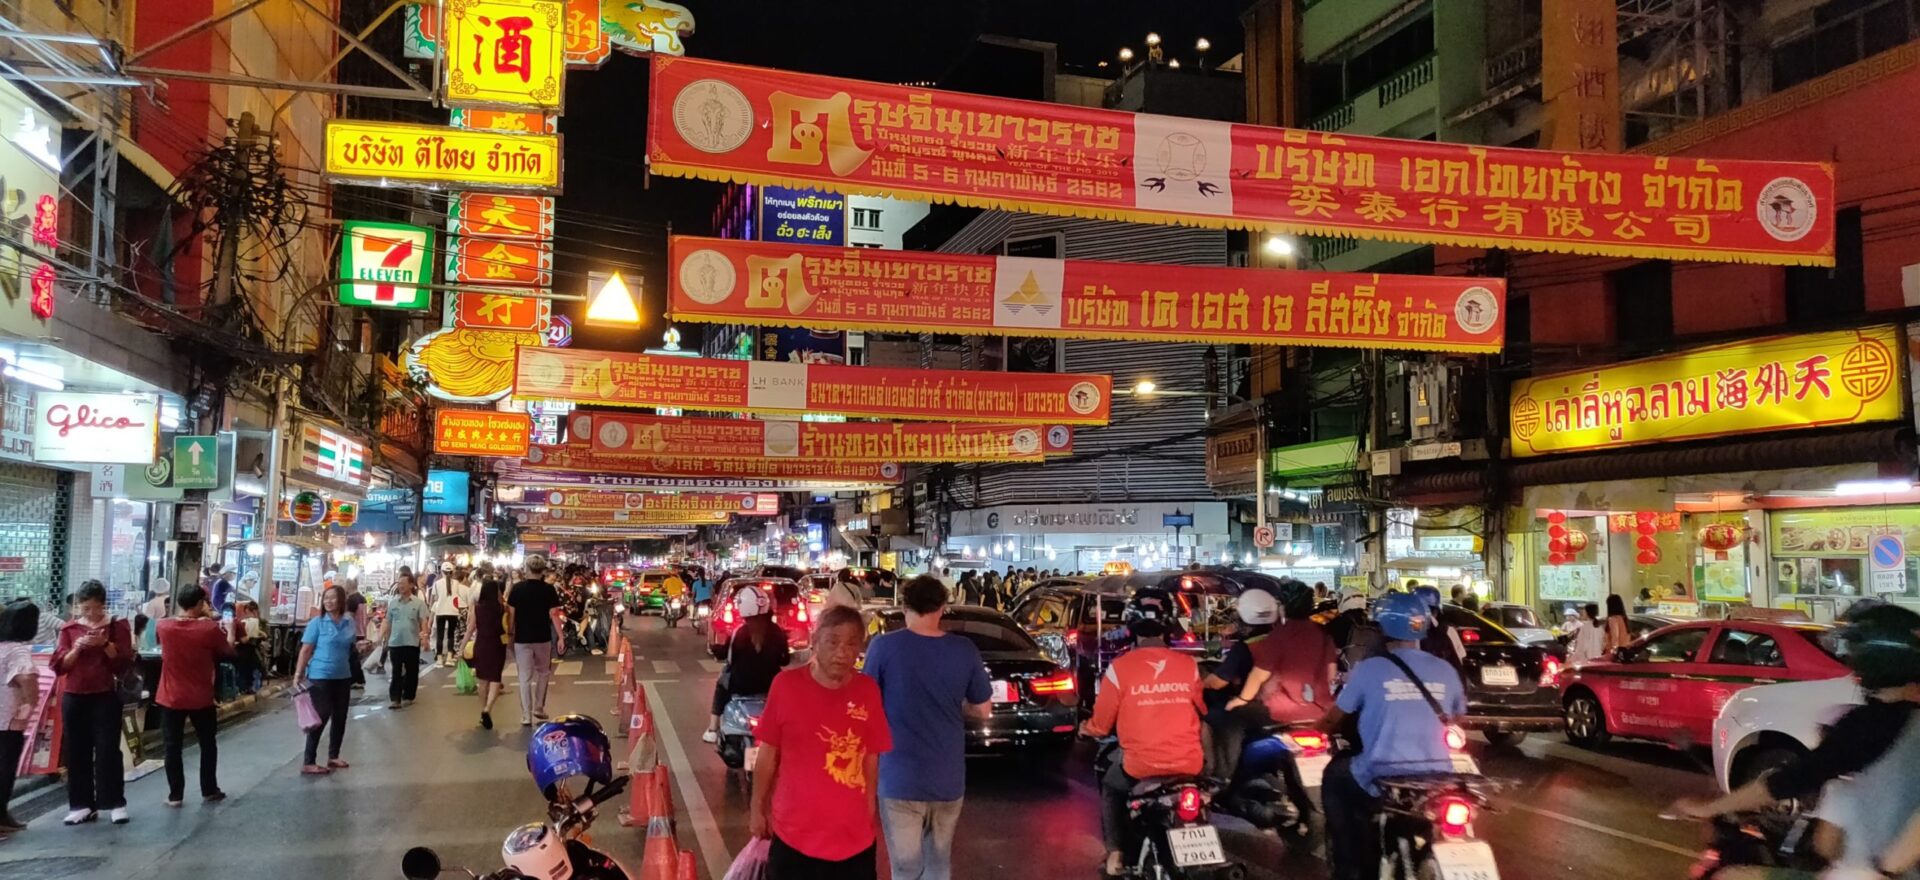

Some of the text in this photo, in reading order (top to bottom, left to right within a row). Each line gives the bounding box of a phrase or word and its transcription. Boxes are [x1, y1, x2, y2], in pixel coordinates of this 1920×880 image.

[473, 16, 533, 83] 酒
[343, 135, 541, 175] บริษัท ดีไทย จำกัด
[767, 91, 1120, 176] ตรุษจีนเยาวราช
[1007, 143, 1118, 168] 新年快乐
[872, 155, 906, 179] วันที่
[965, 168, 1057, 193] กุมภาพันธ์
[1067, 180, 1122, 199] 2562
[1256, 129, 1375, 187] บริษัท
[1401, 146, 1622, 205] เอกไทยห้าง
[1643, 157, 1743, 212] จำกัด
[812, 225, 832, 240] เส็ง
[1287, 185, 1711, 244] 奕泰行有限公司
[363, 234, 413, 301] 7
[476, 196, 532, 324] 大金行
[745, 250, 992, 314] ตรุษจีนเยาวราช
[816, 298, 841, 315] วันที่
[882, 303, 946, 321] กุมภาพันธ์
[952, 307, 991, 321] 2562
[912, 282, 990, 297] 新年快乐
[1068, 274, 1446, 338] บริษัท เค เอส เจ ลีสซิ่ง จำกัด
[714, 394, 741, 403] 2562
[752, 377, 805, 387] LH BANK
[1023, 394, 1066, 413] เยาวราช
[1716, 354, 1831, 410] 海外天
[47, 404, 144, 437] Glico
